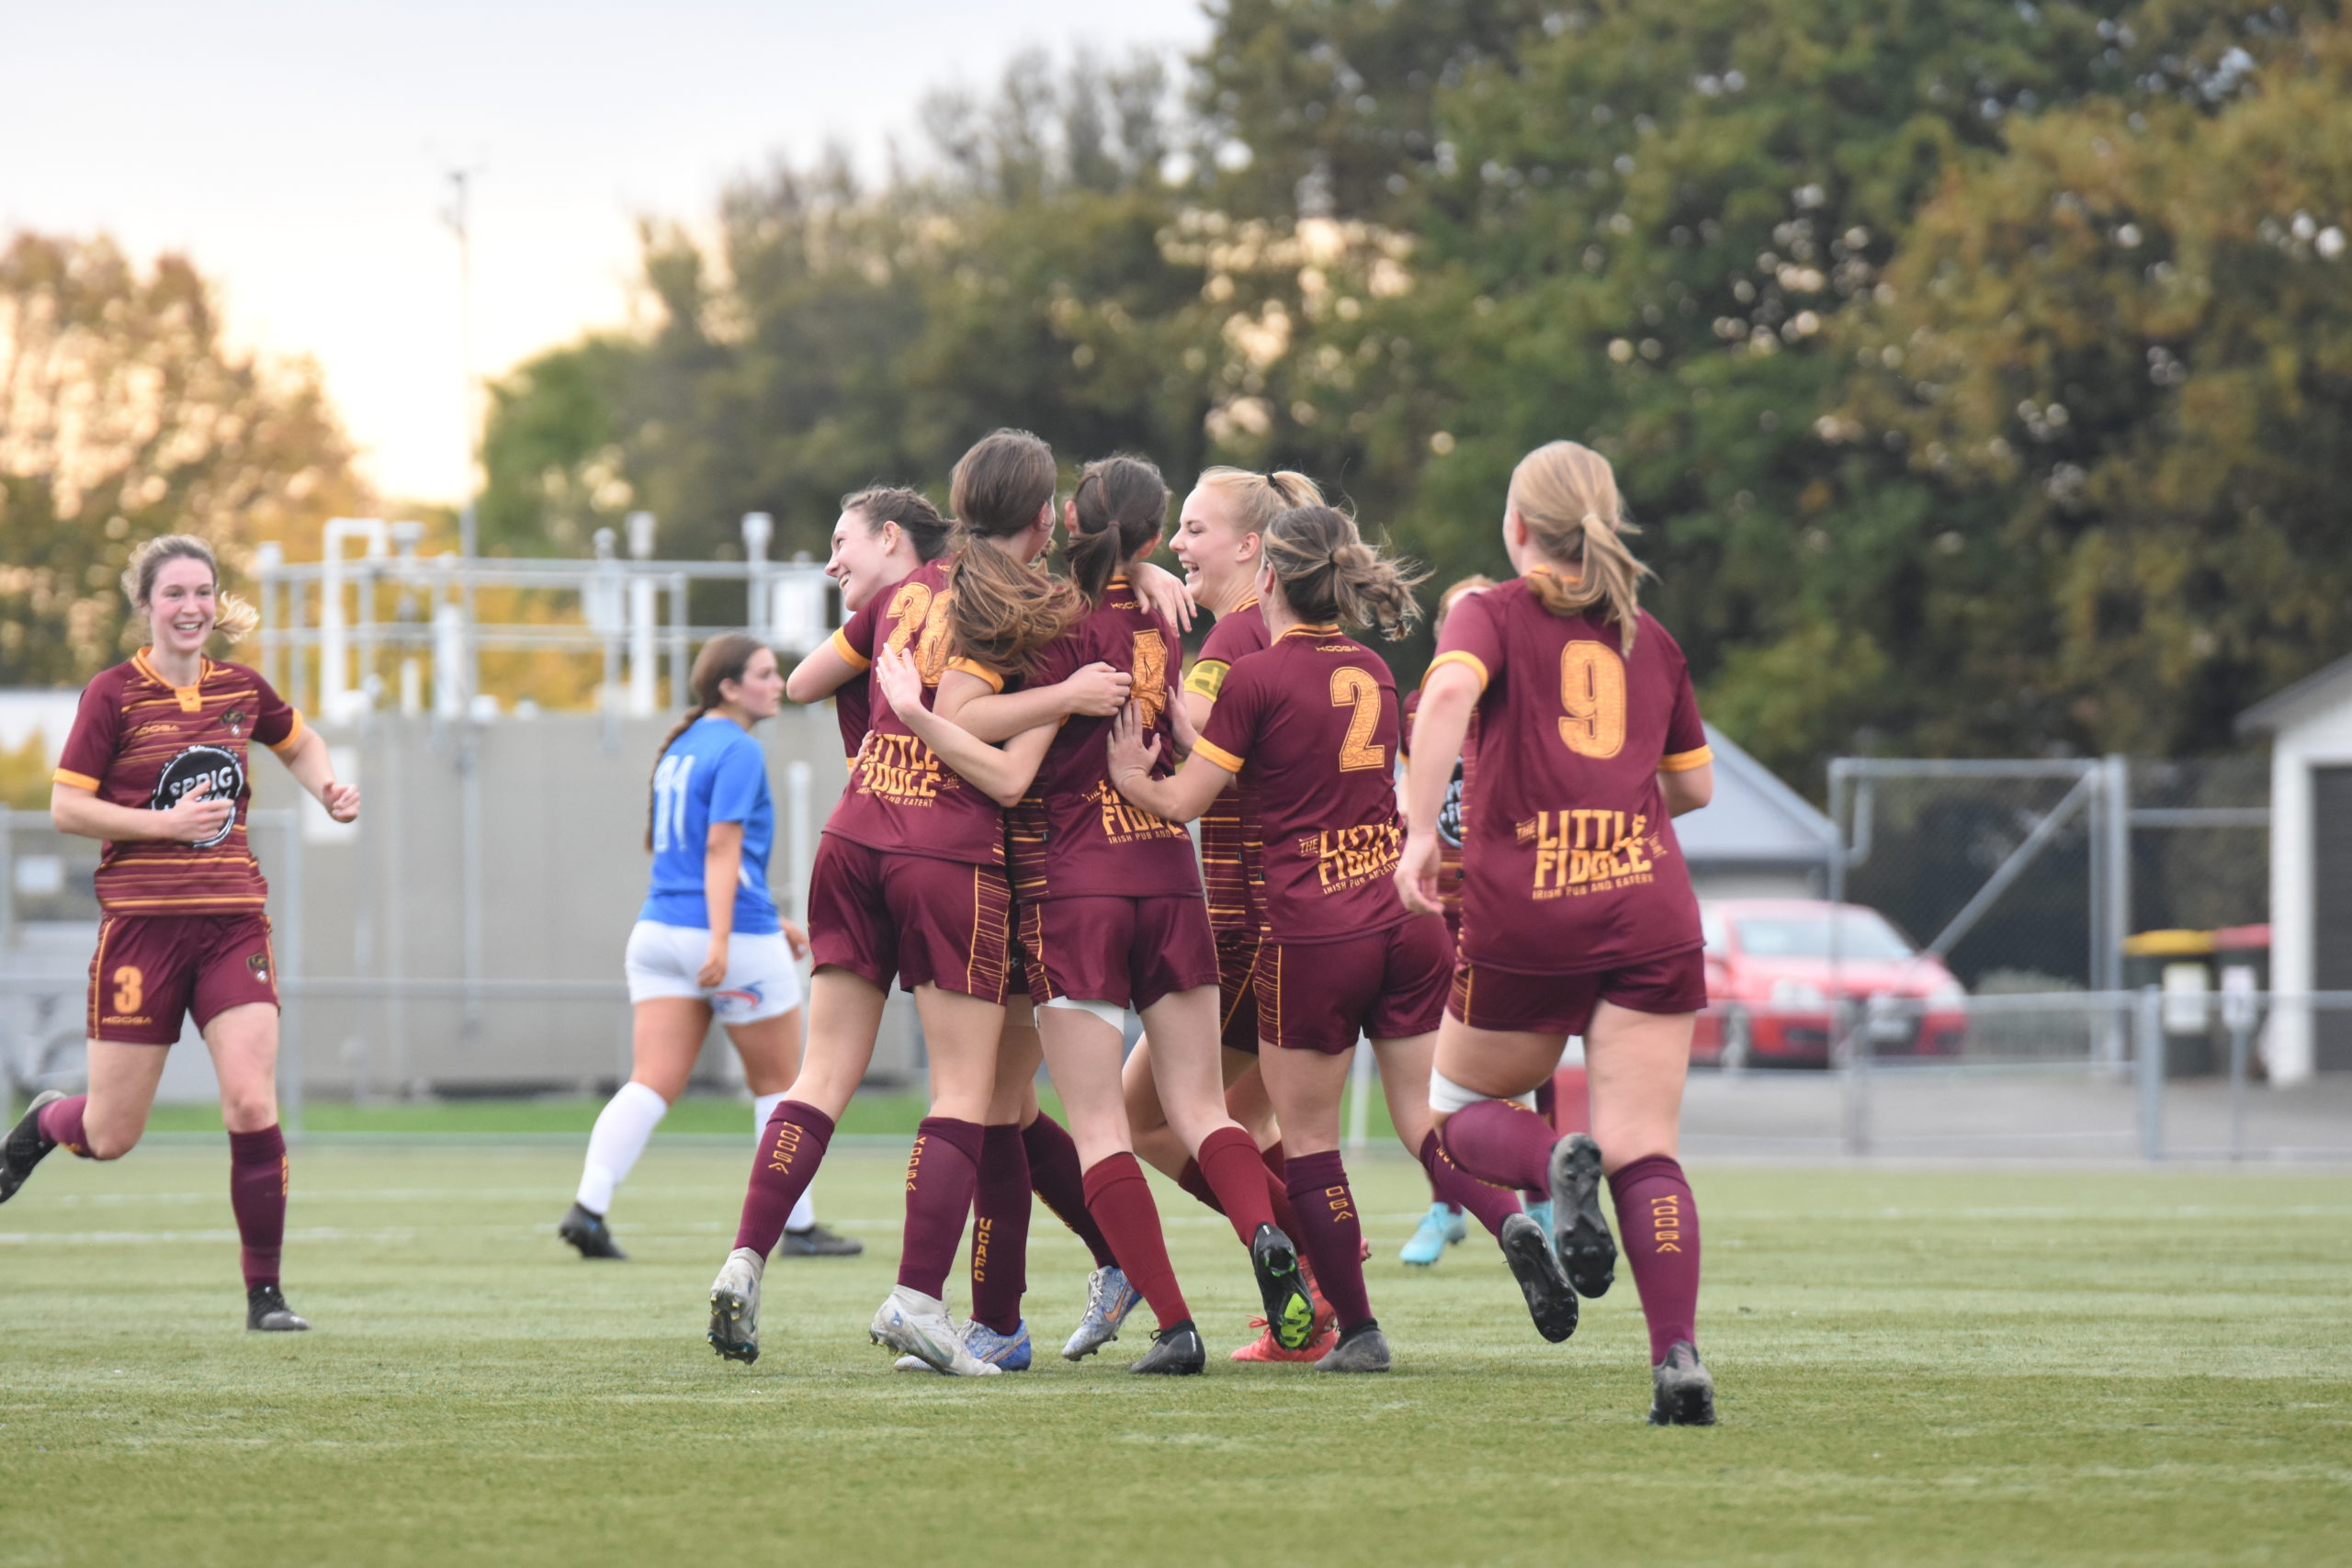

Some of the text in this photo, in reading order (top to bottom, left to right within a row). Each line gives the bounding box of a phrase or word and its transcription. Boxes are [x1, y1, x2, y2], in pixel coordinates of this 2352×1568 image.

[1330, 666, 1385, 772] 2
[1558, 639, 1626, 759] 9
[653, 755, 695, 853] 11
[861, 762, 942, 797] IDDLE
[1108, 834, 1133, 844] IRISH
[1136, 830, 1153, 840] PUB
[1156, 829, 1171, 838] AND
[1300, 838, 1319, 853] THE
[1537, 809, 1647, 849] LITTLE
[1532, 887, 1562, 900] IRISH
[1566, 885, 1588, 897] PUB
[1590, 879, 1613, 893] AND
[112, 965, 143, 1014] 3
[101, 1016, 153, 1025] KOOGA
[768, 1121, 804, 1175] KOOGA
[906, 1136, 927, 1191] KOOGA
[1651, 1194, 1682, 1254] KOOGA
